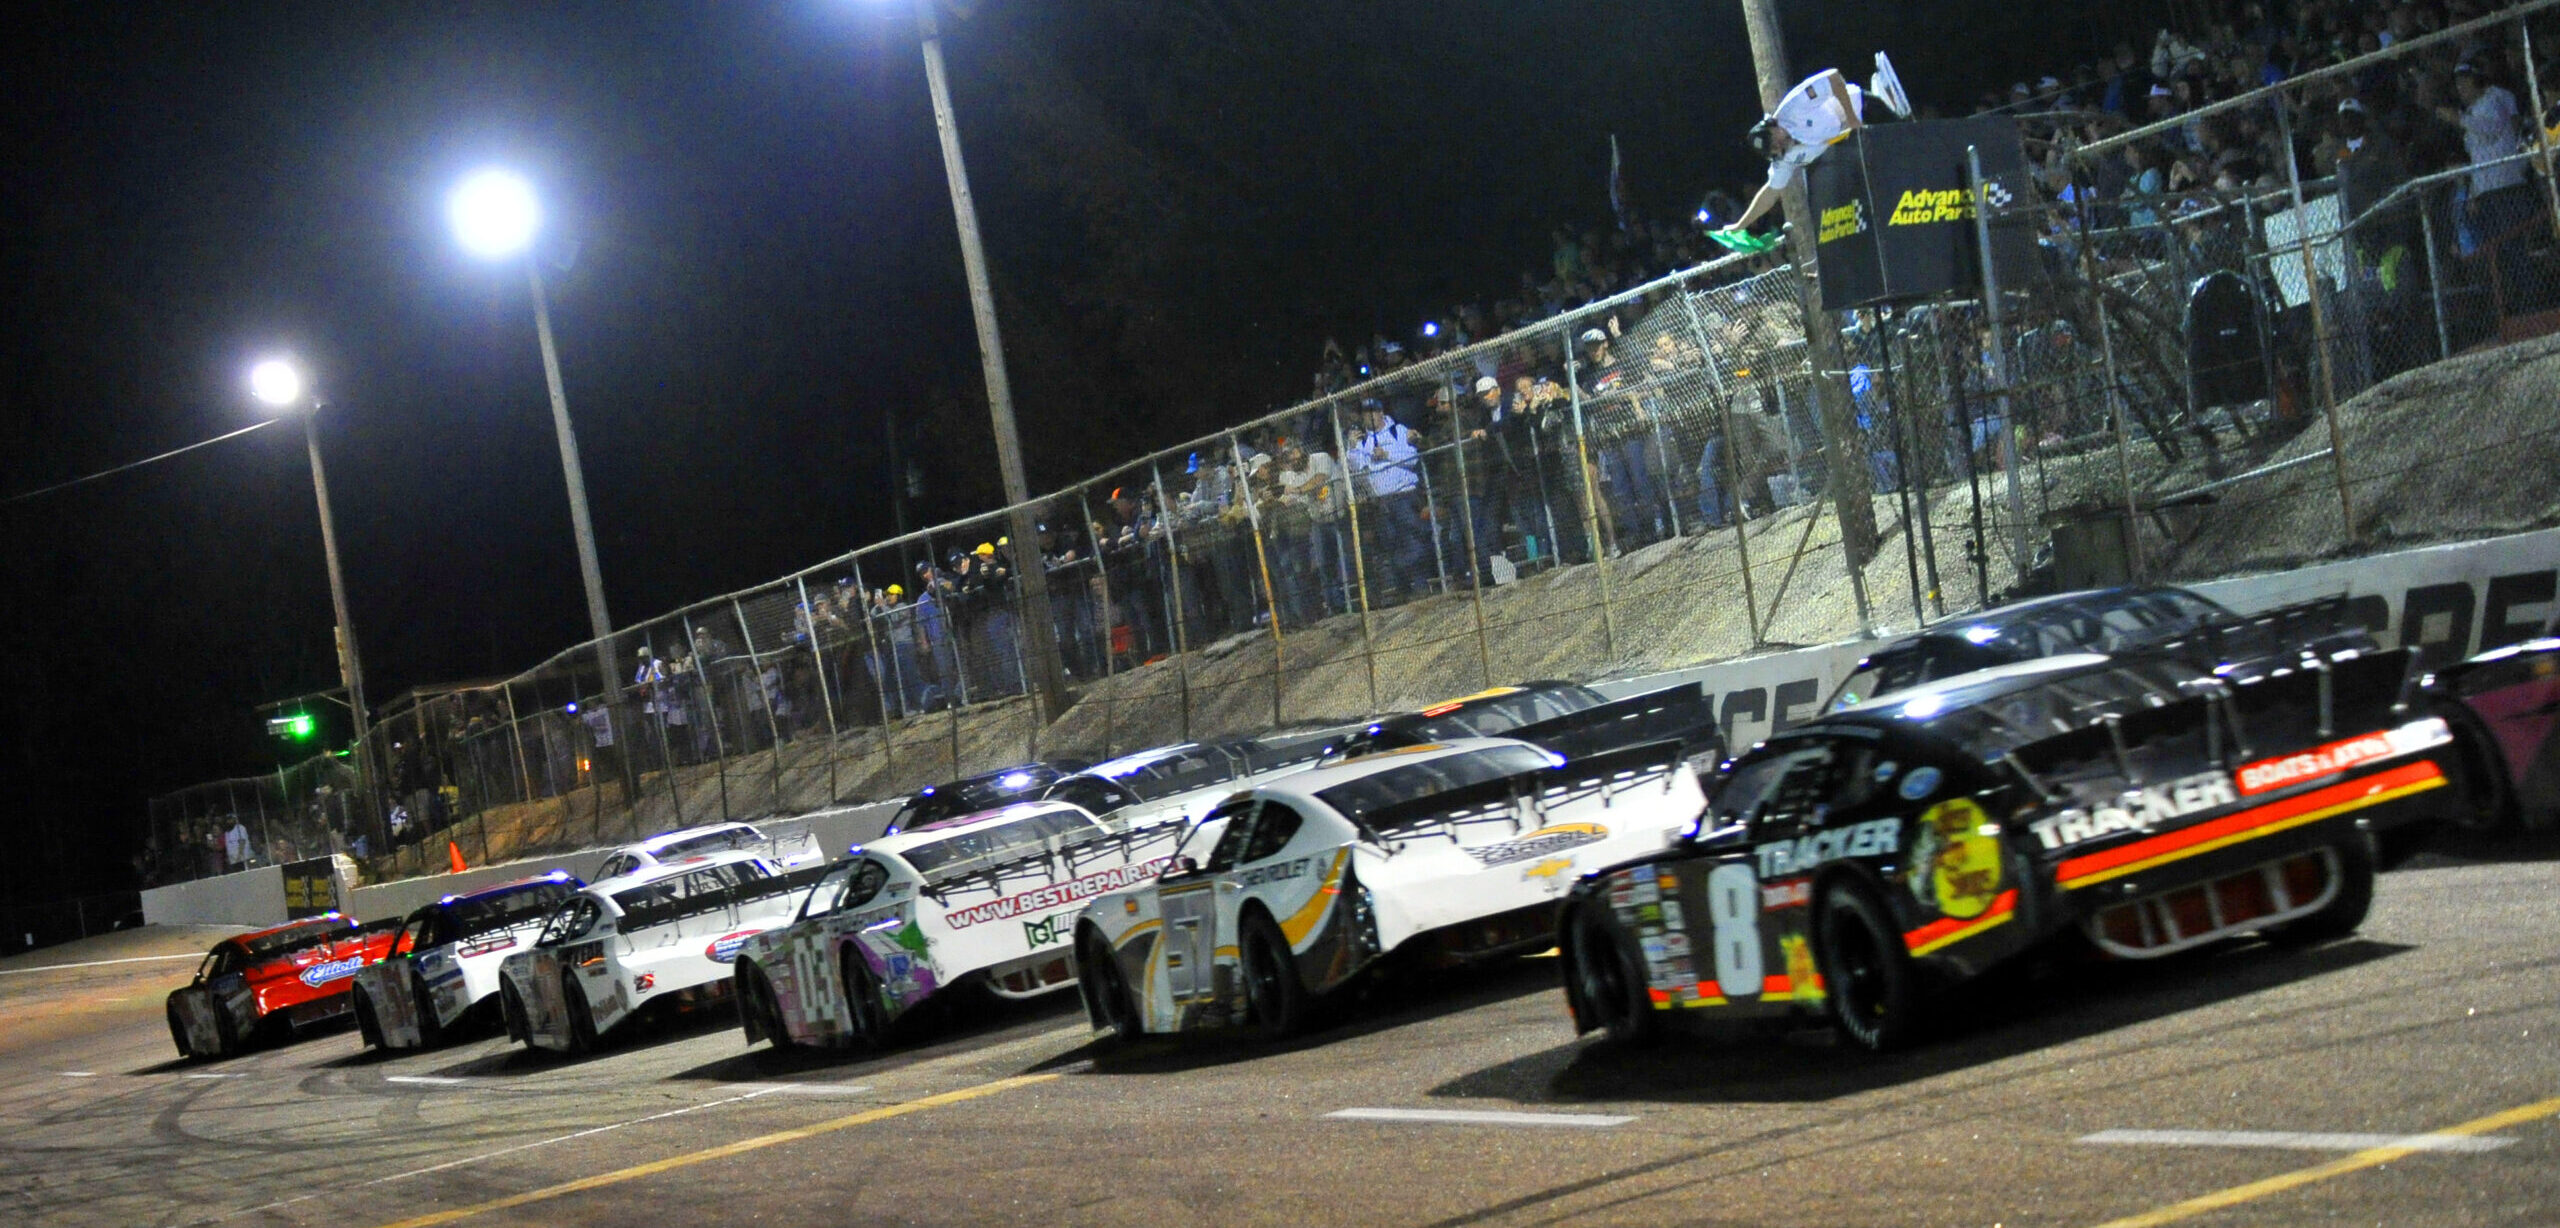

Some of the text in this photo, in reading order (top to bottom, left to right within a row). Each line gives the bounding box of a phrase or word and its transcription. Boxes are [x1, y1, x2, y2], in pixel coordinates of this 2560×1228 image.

[1888, 208, 1932, 226] Auto
[2240, 754, 2319, 790] BOATS
[2029, 770, 2241, 851] TRACKER
[1753, 816, 1904, 880] TRACKER
[1707, 863, 1764, 997] 8
